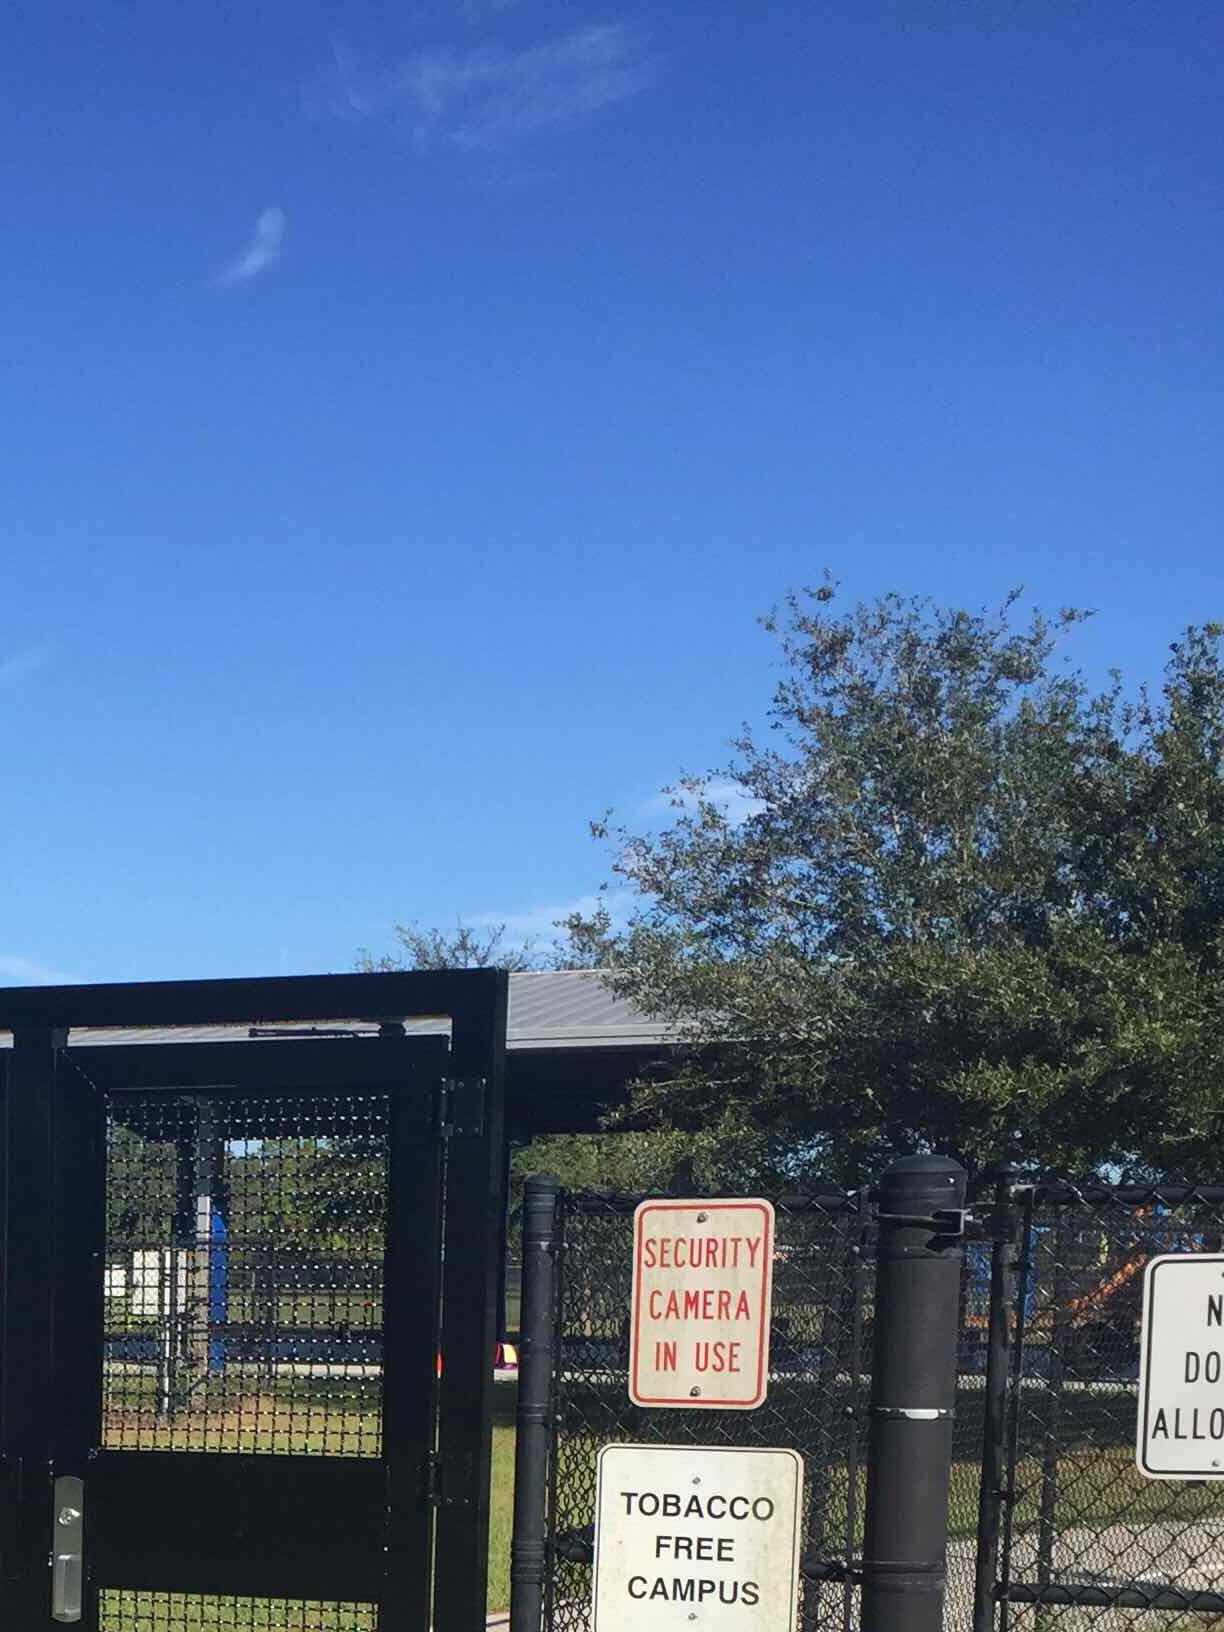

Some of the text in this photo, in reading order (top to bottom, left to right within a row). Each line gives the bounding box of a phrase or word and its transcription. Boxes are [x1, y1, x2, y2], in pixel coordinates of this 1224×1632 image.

[644, 1237, 761, 1269] SECURITY
[649, 1290, 751, 1321] CAMERA
[656, 1342, 741, 1373] IN USE
[1185, 1351, 1222, 1384] DO
[1152, 1408, 1224, 1440] ALLO
[621, 1492, 775, 1522] TOBACCO
[656, 1535, 735, 1562] FREE
[627, 1576, 760, 1606] CAMPUS
